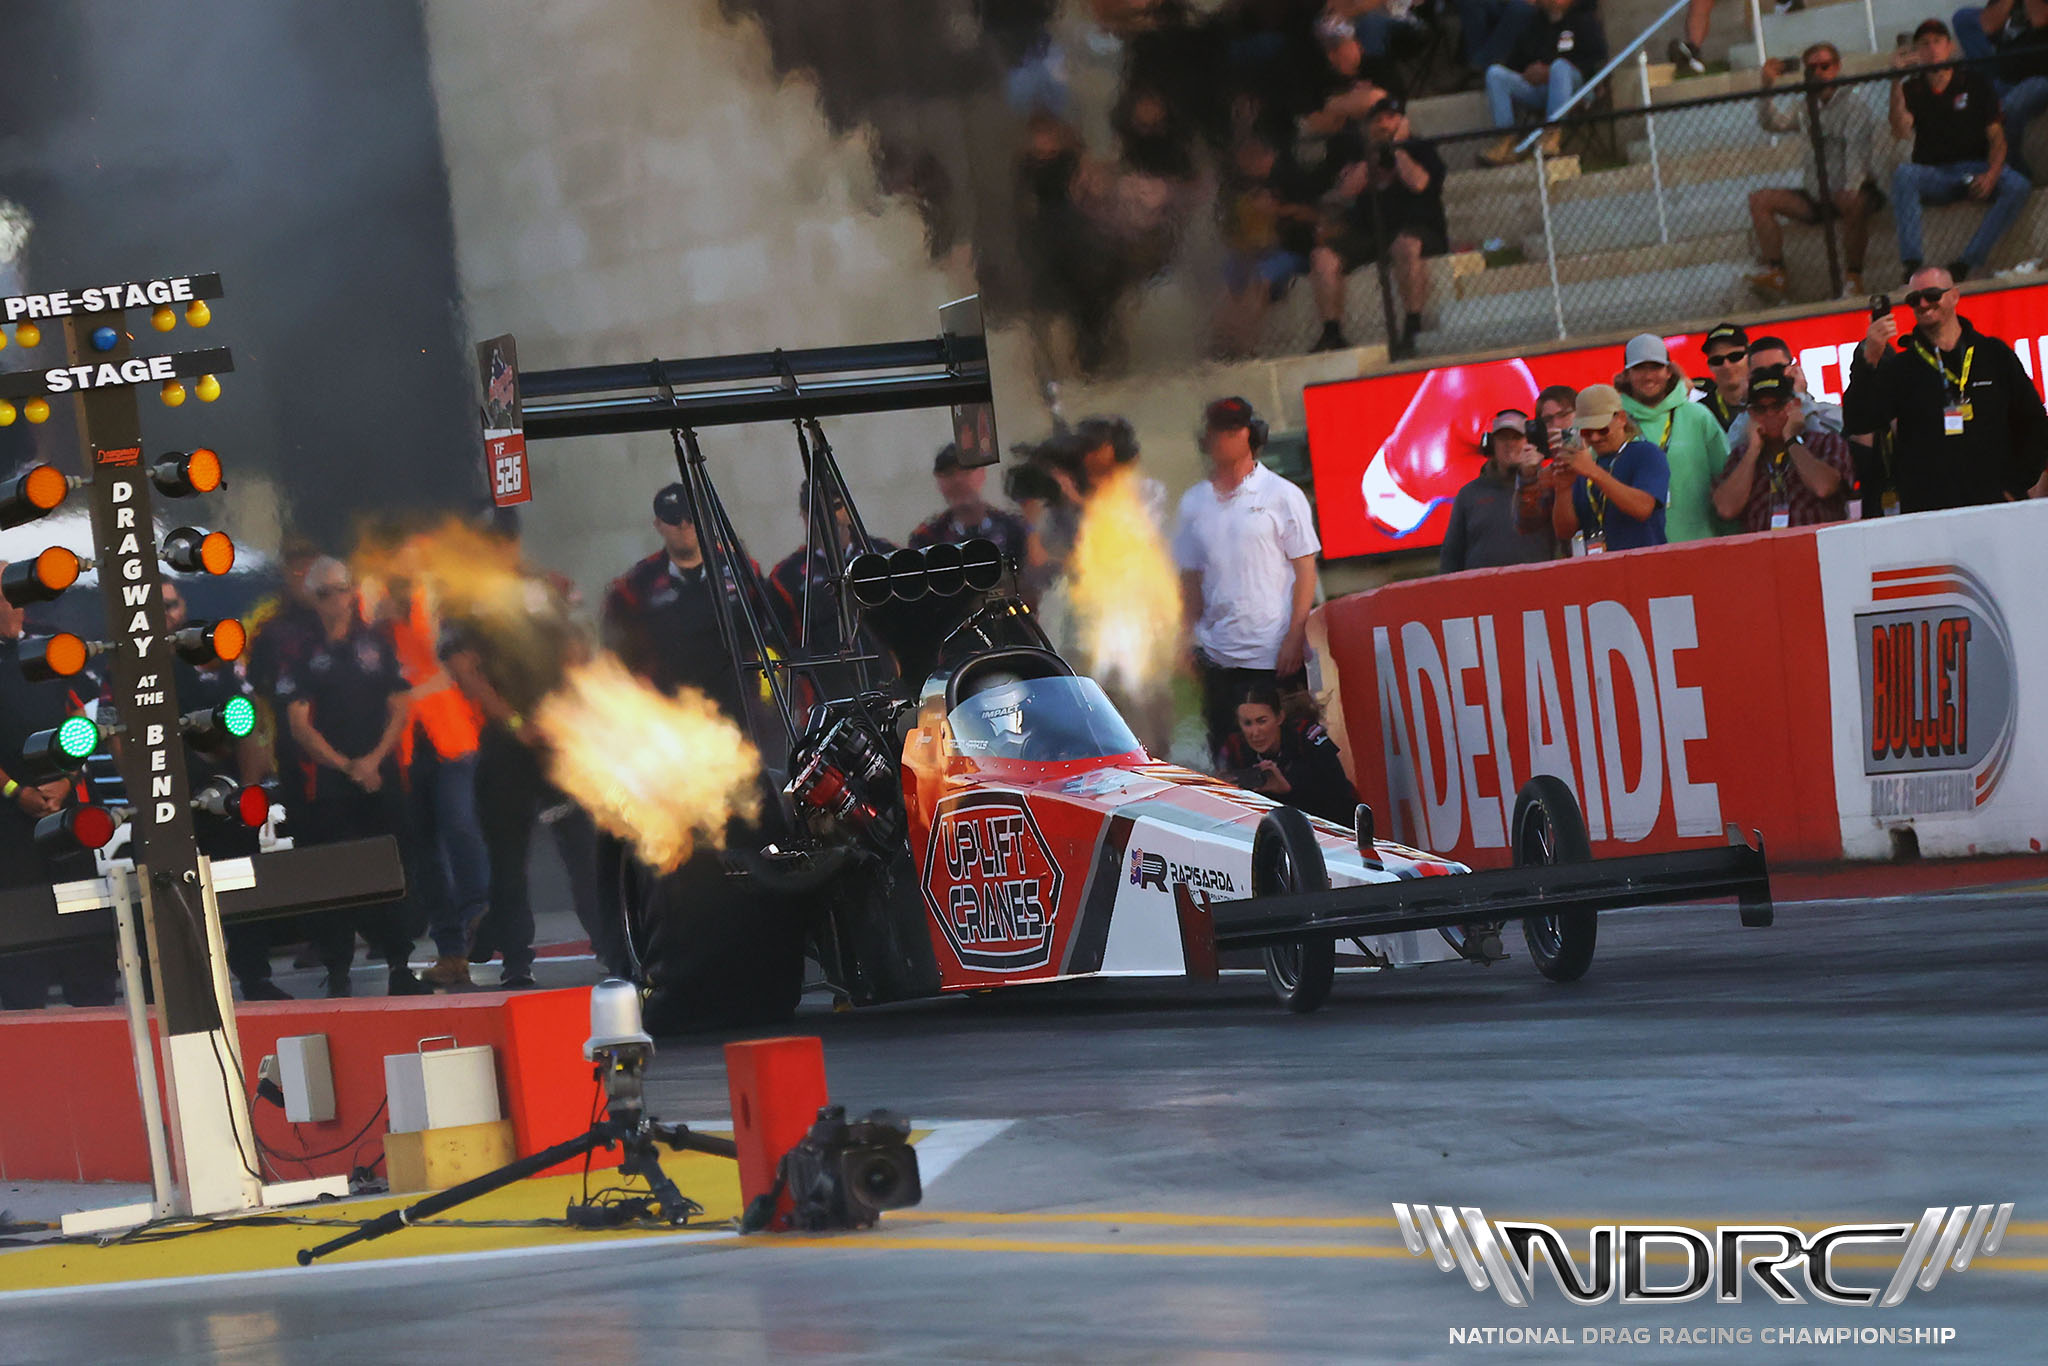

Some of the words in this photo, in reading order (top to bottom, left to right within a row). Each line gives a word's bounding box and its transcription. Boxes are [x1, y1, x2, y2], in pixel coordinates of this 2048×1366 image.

[5, 278, 195, 320] PRE-STAGE
[45, 356, 177, 393] STAGE
[112, 481, 152, 658] DRAGWAY
[135, 691, 164, 707] THE
[137, 674, 158, 689] AT
[1872, 616, 1972, 761] BULLET
[981, 704, 1021, 720] IMPACT
[1373, 595, 1724, 853] ADELAIDE
[146, 724, 176, 824] BEND
[942, 814, 1026, 881] UPLIFT
[1170, 862, 1235, 893] RAPISARDA
[949, 879, 1047, 944] CRANES
